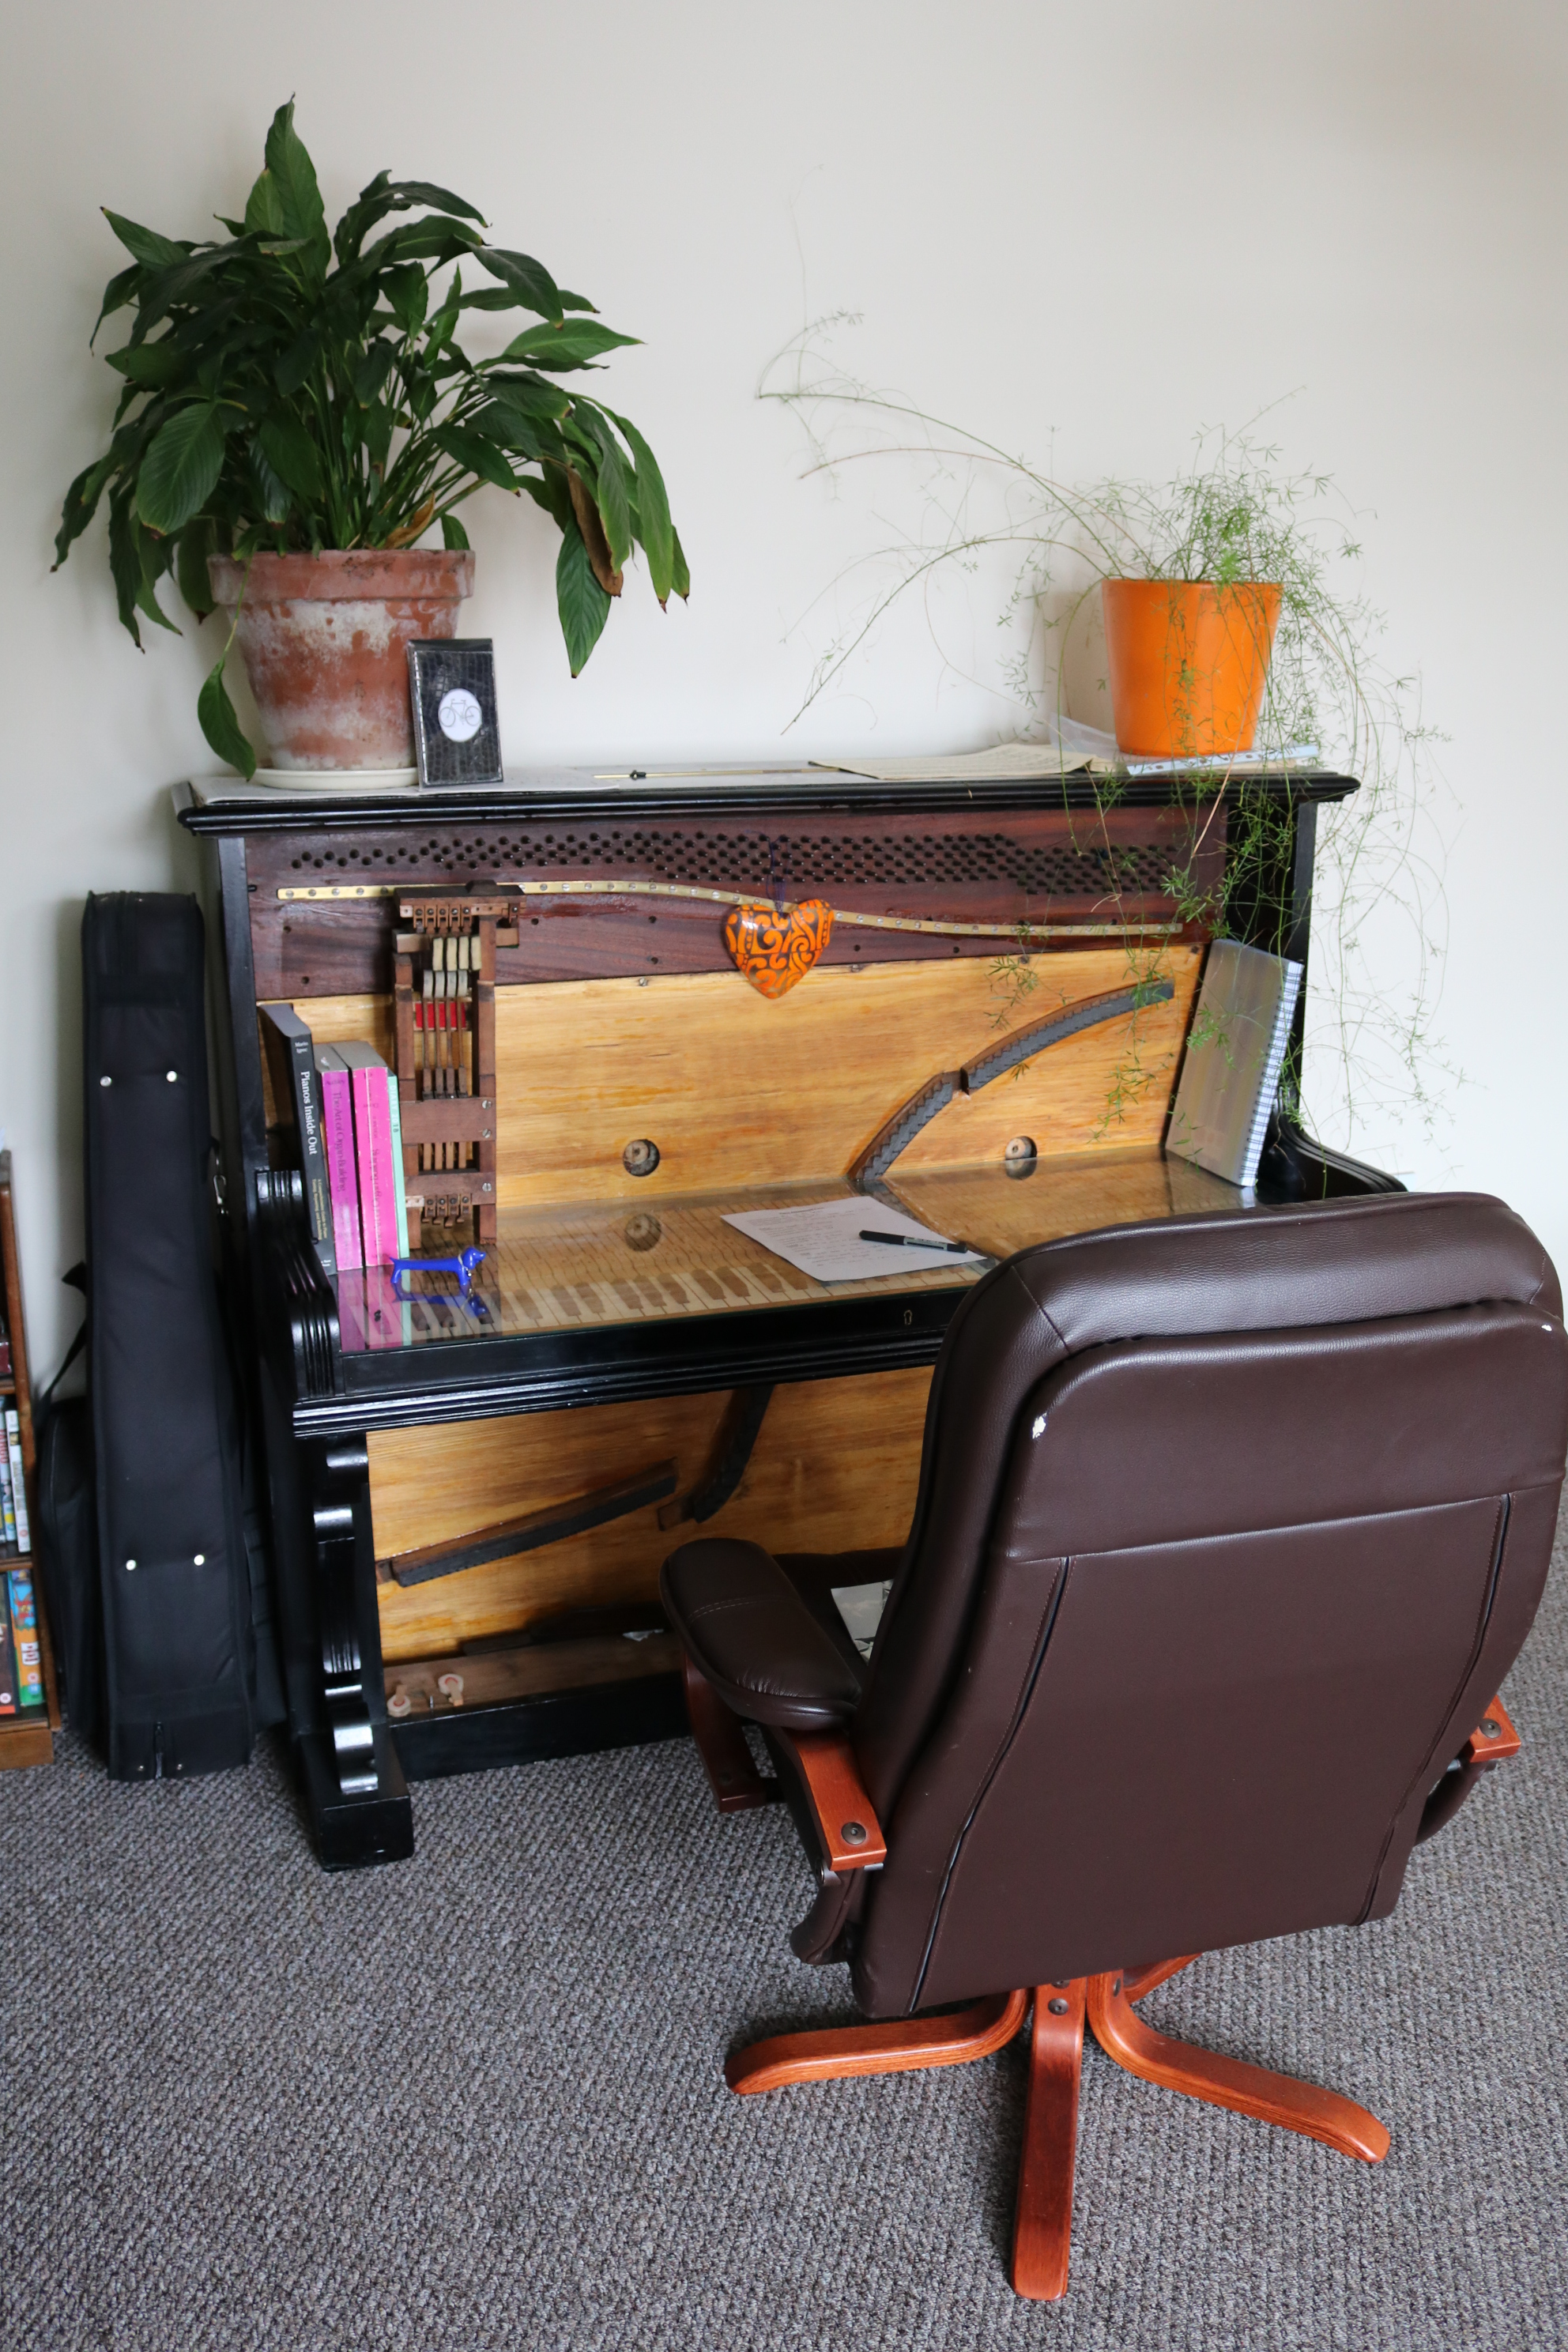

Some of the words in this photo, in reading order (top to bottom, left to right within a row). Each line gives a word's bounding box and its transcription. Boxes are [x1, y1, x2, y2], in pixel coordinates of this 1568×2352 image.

[300, 1071, 311, 1104] Pianos
[332, 1091, 342, 1105] The
[390, 1085, 399, 1110] DIARY
[304, 1105, 316, 1136] Inside
[334, 1108, 342, 1121] Art
[391, 1114, 400, 1133] 2018
[335, 1122, 343, 1133] of
[307, 1136, 318, 1155] Out
